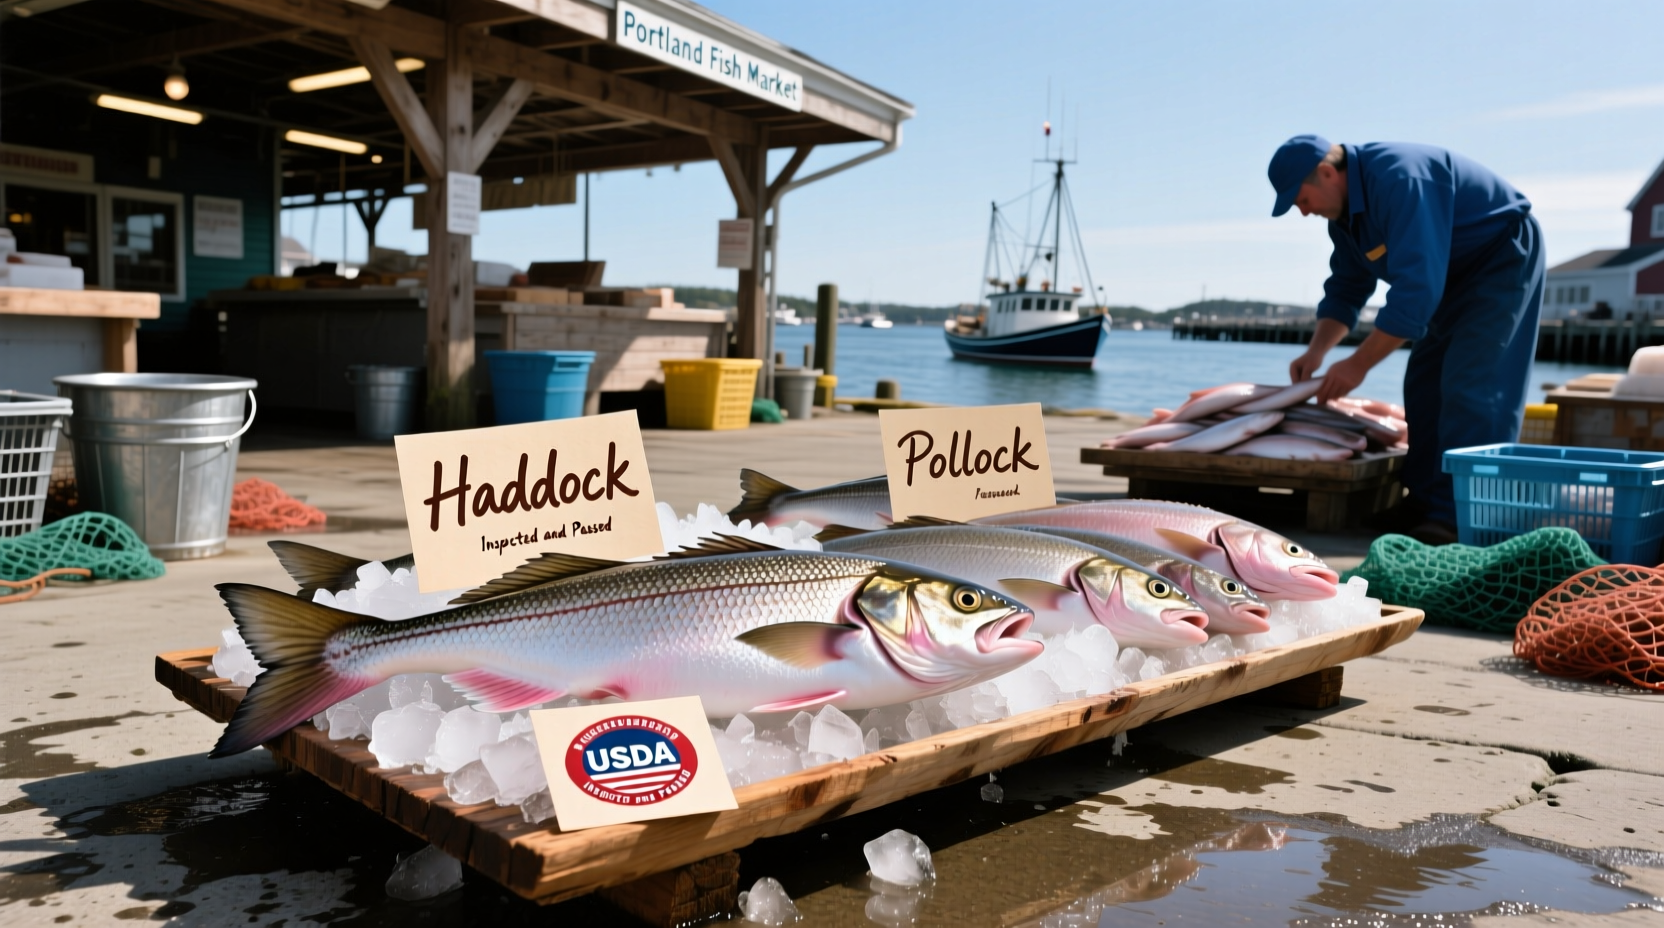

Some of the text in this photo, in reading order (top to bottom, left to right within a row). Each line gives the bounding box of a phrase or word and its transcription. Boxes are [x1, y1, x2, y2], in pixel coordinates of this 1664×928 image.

[624, 10, 797, 101] Portland Fish Market
[423, 441, 640, 532] Haddock
[897, 426, 1039, 487] Pollock
[543, 523, 567, 540] and
[572, 515, 612, 537] Passed
[585, 741, 677, 772] USDA
